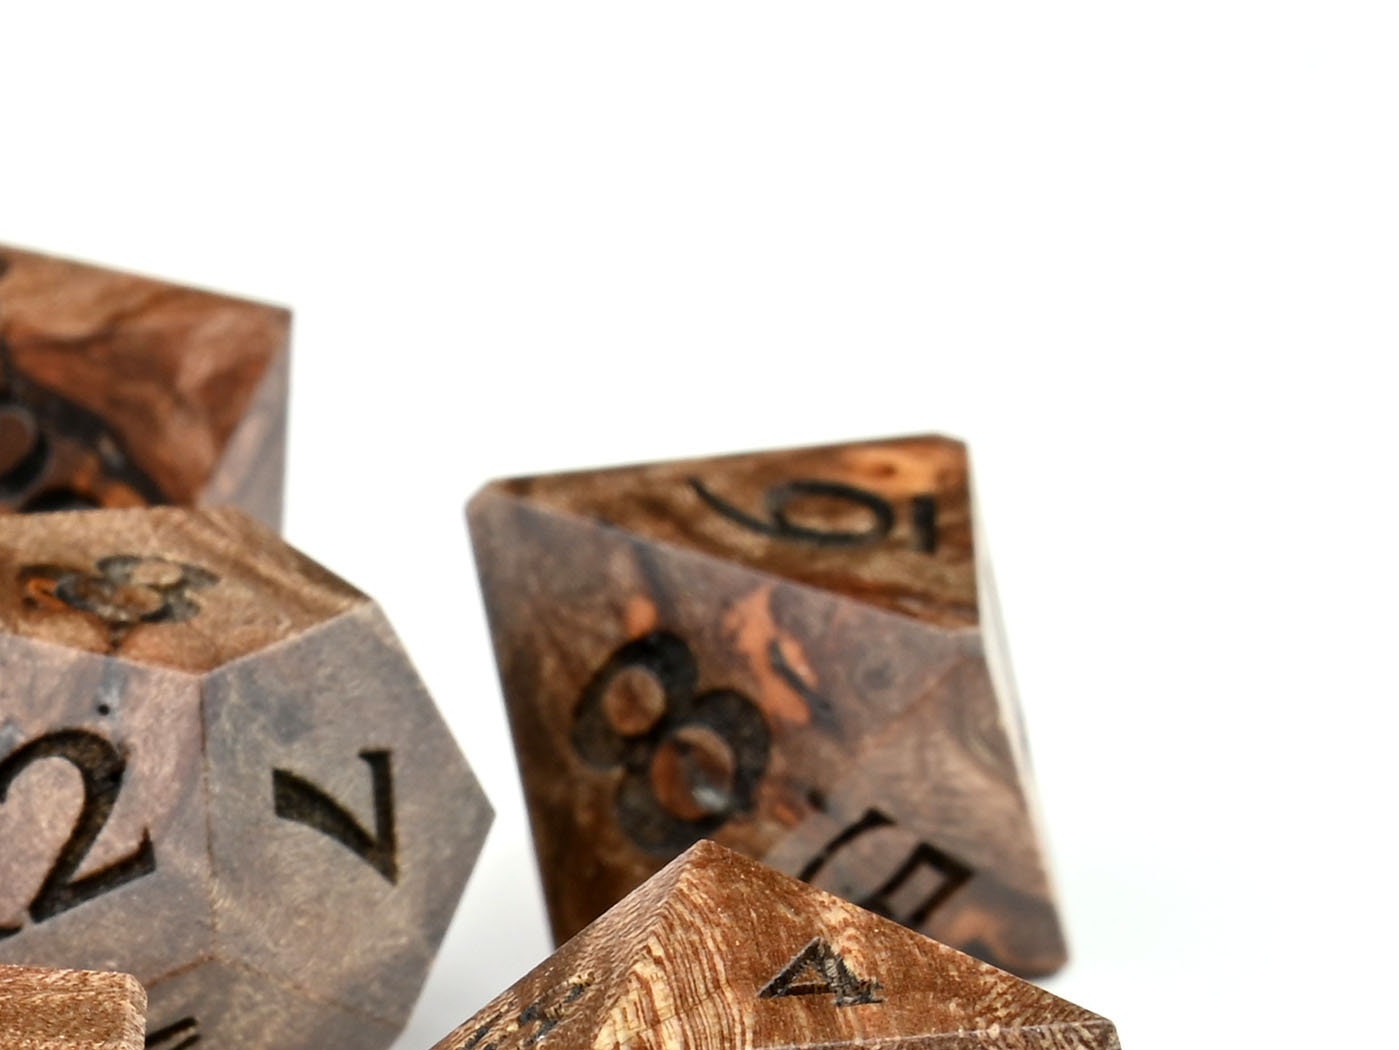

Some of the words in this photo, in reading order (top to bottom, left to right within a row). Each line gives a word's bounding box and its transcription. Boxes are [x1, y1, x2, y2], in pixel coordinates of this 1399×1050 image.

[571, 630, 772, 857] 8
[271, 746, 401, 887] 7
[758, 936, 886, 1007] 4
